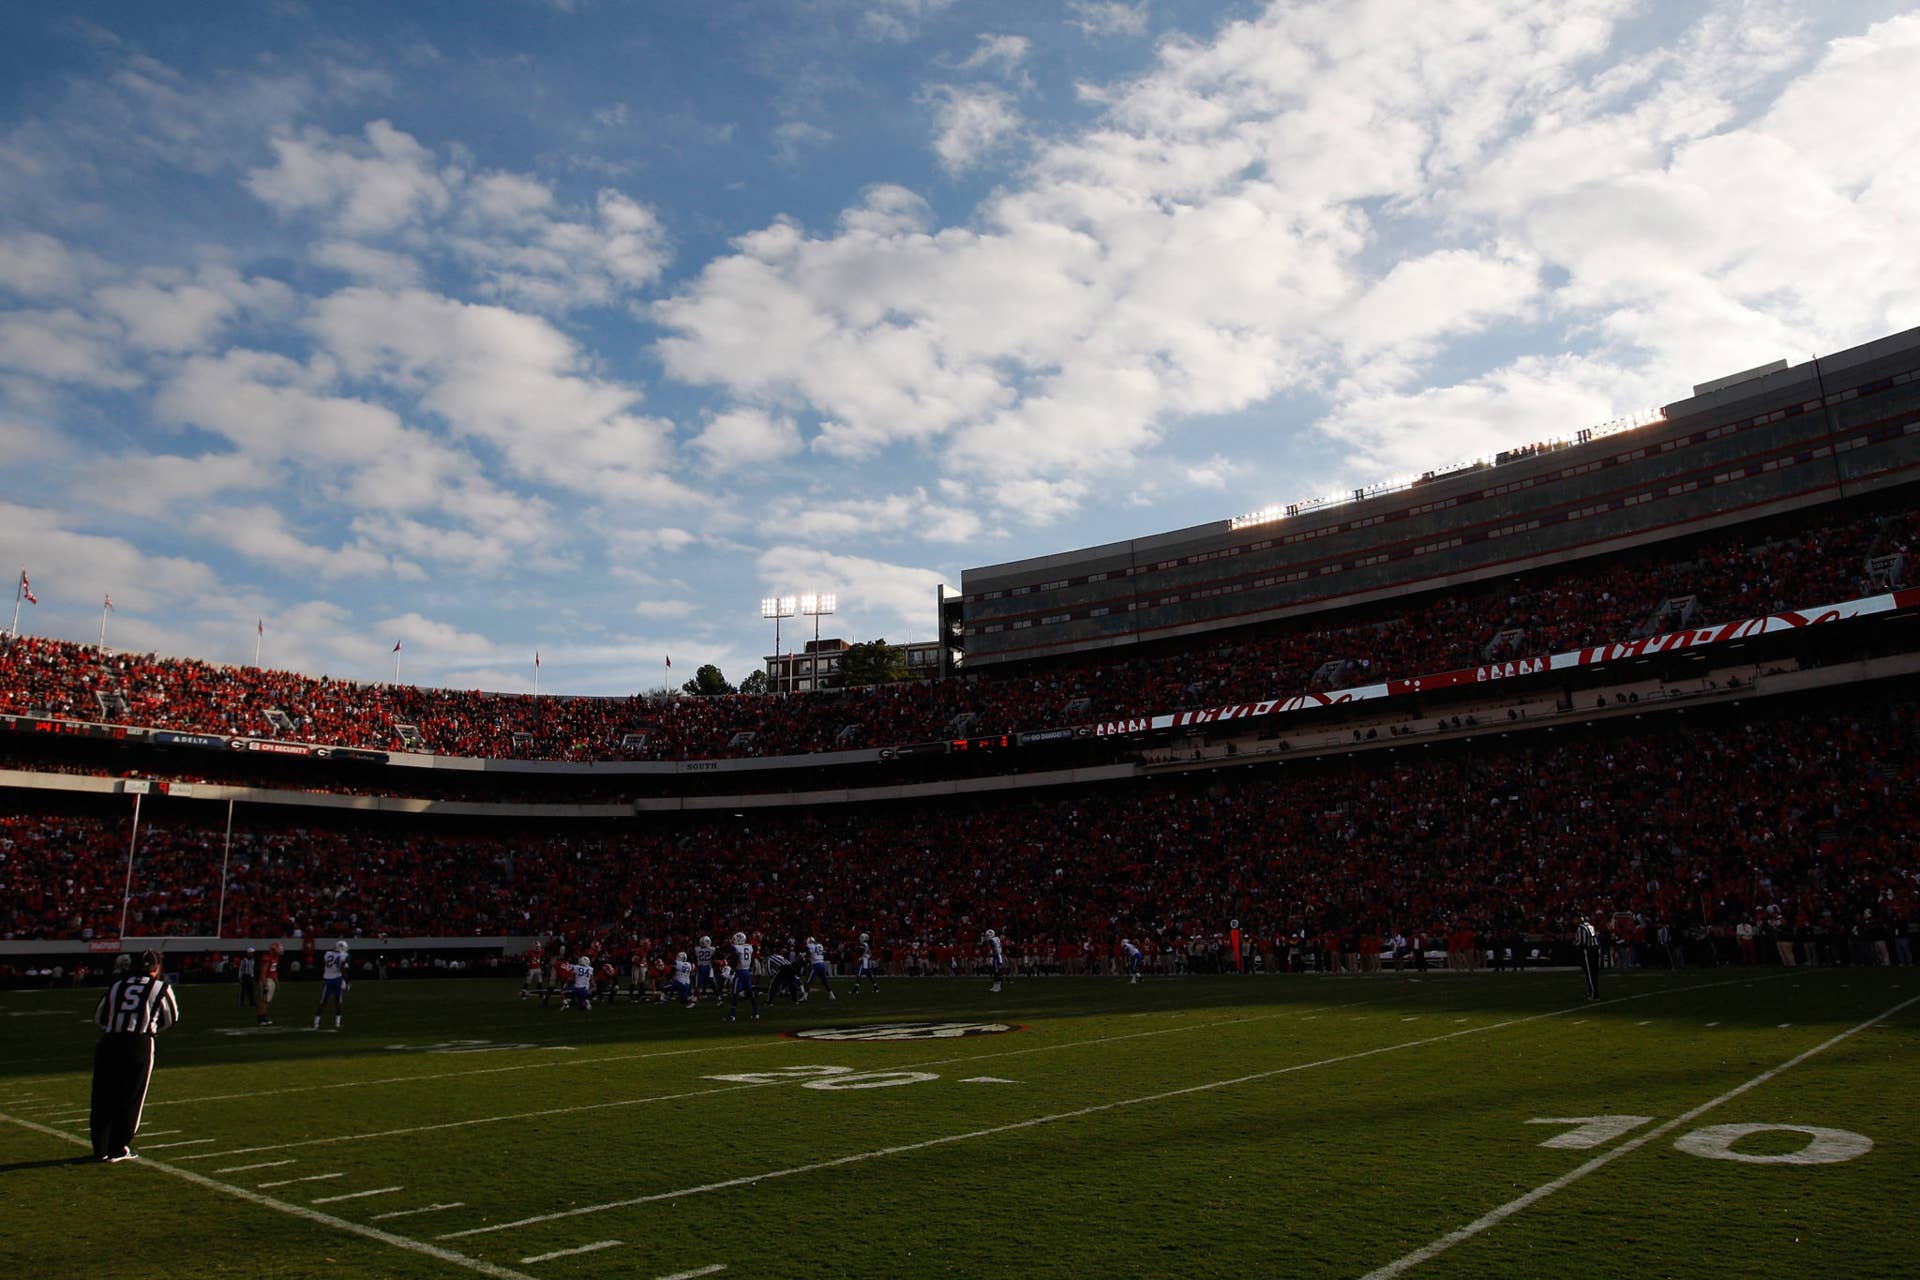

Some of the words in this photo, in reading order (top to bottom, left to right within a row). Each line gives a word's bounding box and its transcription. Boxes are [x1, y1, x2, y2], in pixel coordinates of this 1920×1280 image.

[181, 736, 208, 745] DELTA
[275, 745, 307, 754] SECURITY
[699, 950, 711, 961] 22
[743, 947, 750, 961] 6
[327, 954, 341, 968] 24
[578, 967, 589, 978] 94
[120, 984, 145, 1011] S
